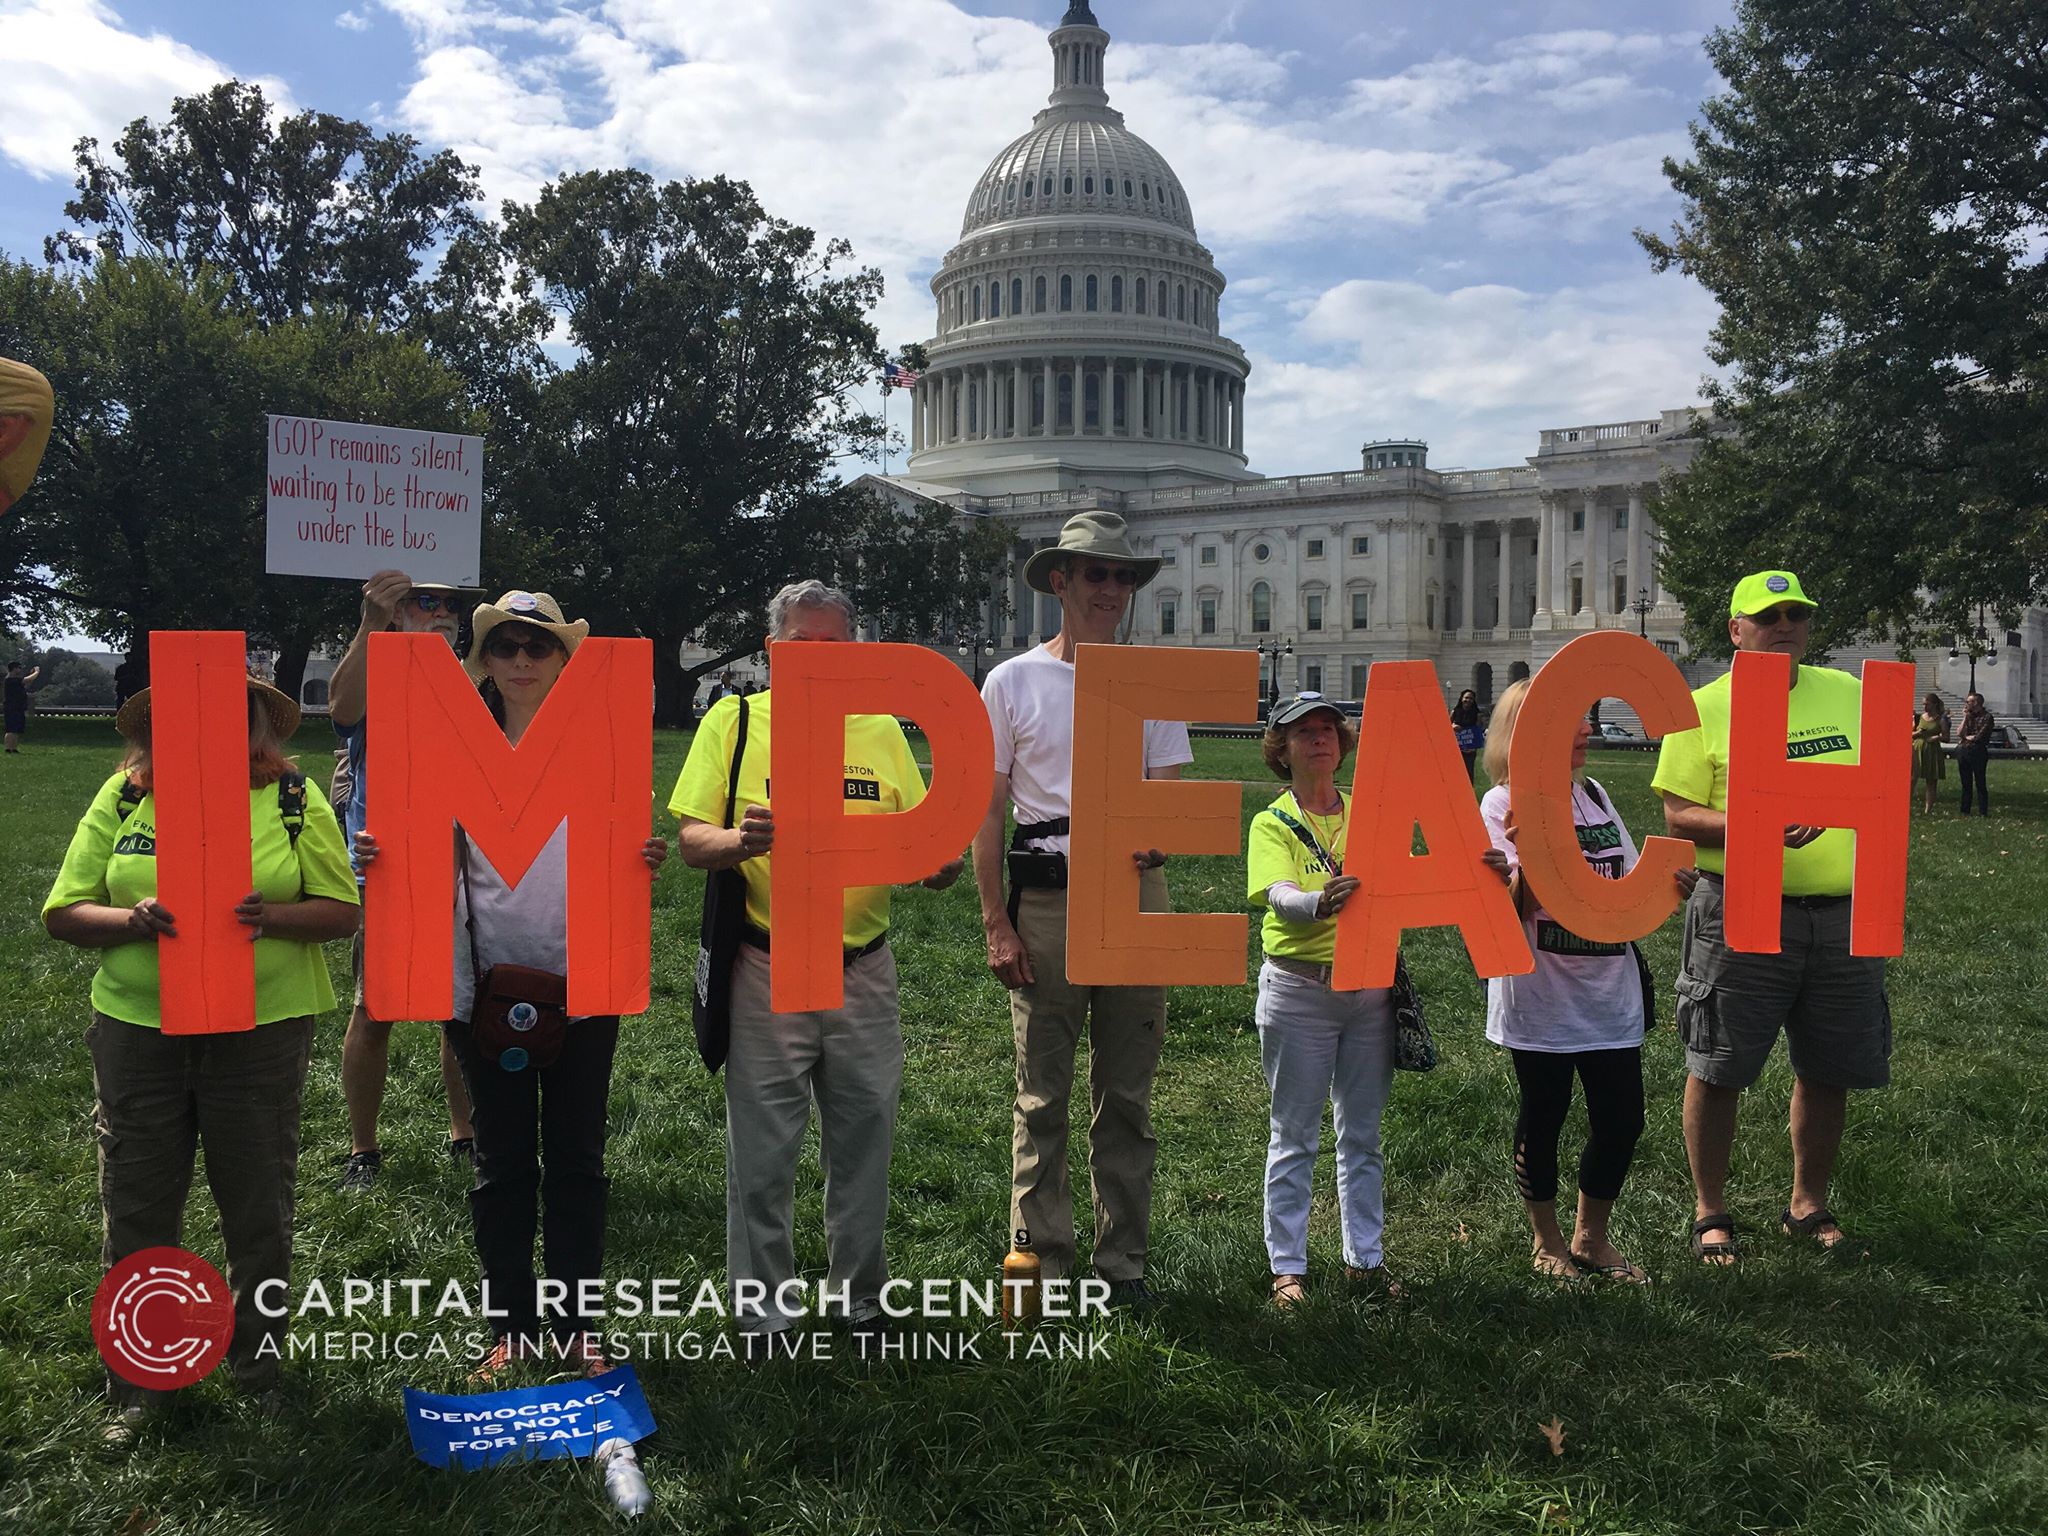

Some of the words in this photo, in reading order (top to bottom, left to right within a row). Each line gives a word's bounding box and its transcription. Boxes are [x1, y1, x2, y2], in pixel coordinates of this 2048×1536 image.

[274, 417, 324, 457] GOP
[330, 435, 401, 465] remains
[411, 436, 470, 476] silent,
[269, 464, 337, 514] waiting
[345, 468, 365, 504] to
[374, 471, 396, 507] be
[403, 474, 468, 513] thrown
[297, 515, 356, 545] under
[363, 512, 394, 547] the
[403, 514, 437, 552] bus
[1805, 725, 1839, 736] RESTON
[848, 783, 874, 796] BLE
[419, 1383, 625, 1422] DEMOCRACY
[448, 1436, 517, 1452] FOR
[525, 1420, 615, 1443] SALE
[472, 1424, 504, 1436] IS
[513, 1412, 582, 1431] NOT
